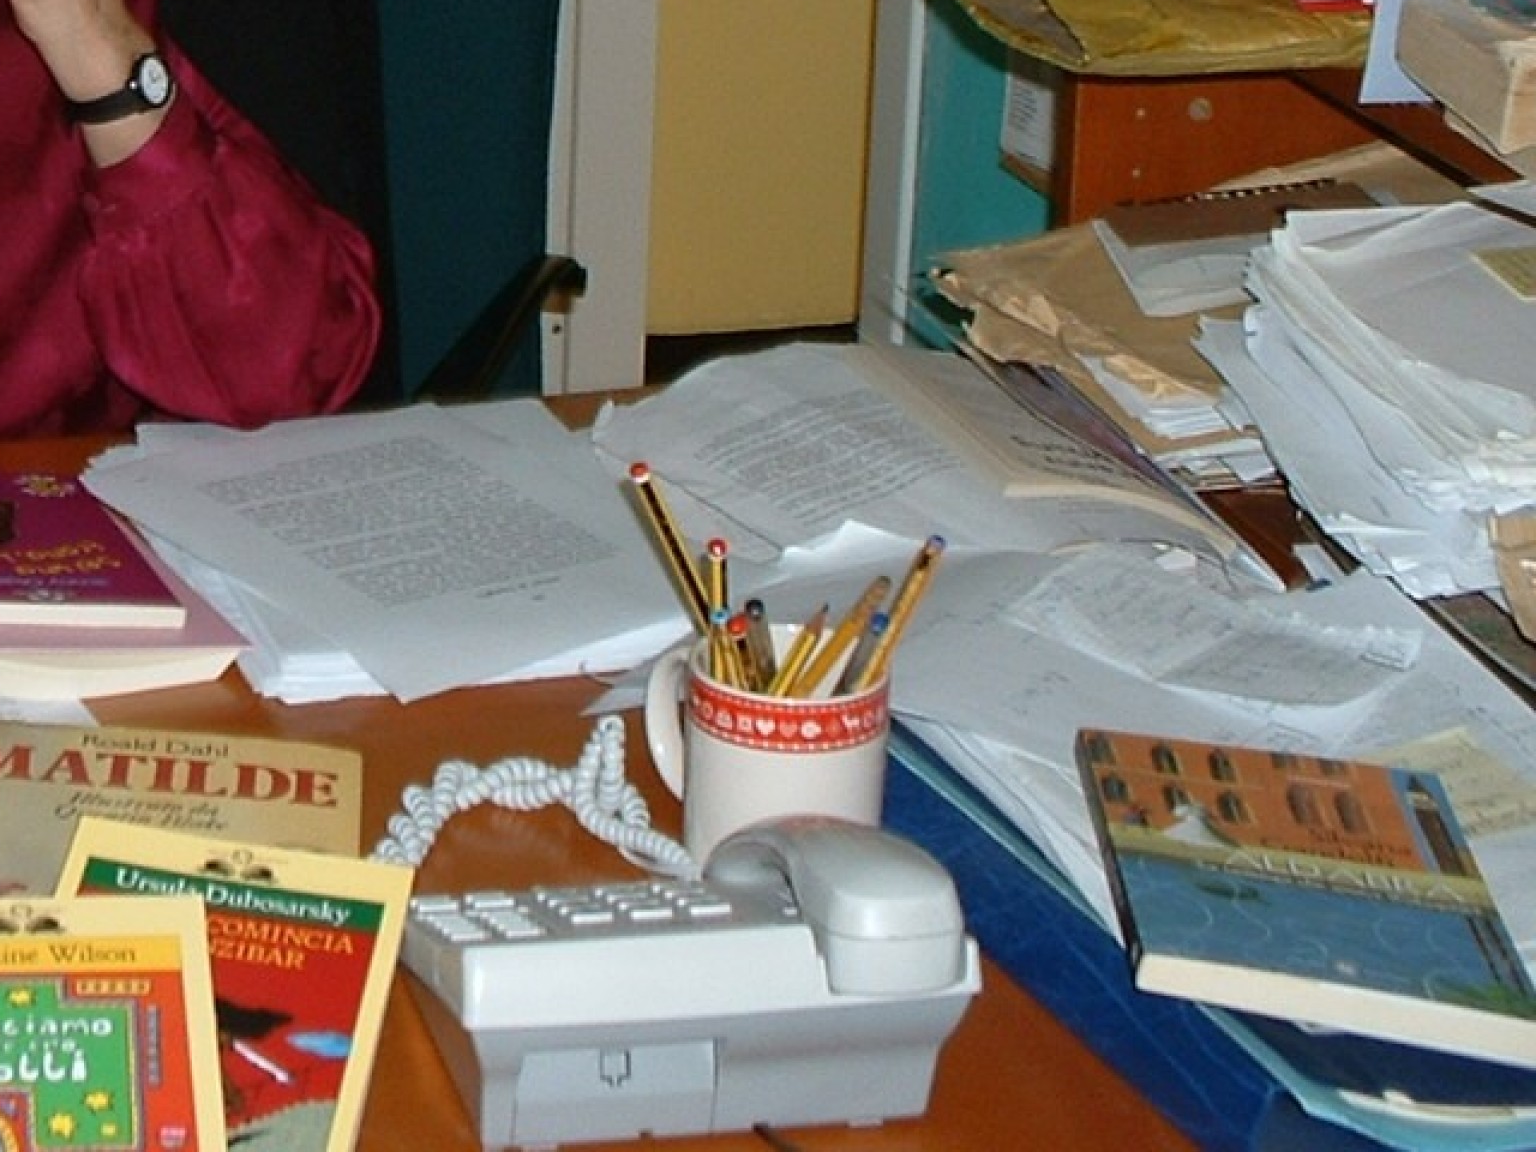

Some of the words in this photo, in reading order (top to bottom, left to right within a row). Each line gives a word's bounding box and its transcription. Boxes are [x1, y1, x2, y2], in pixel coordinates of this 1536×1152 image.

[82, 732, 157, 753] Roald
[165, 737, 229, 758] Dahl
[206, 882, 352, 927] Dubosarsky
[49, 944, 138, 965] Wilson
